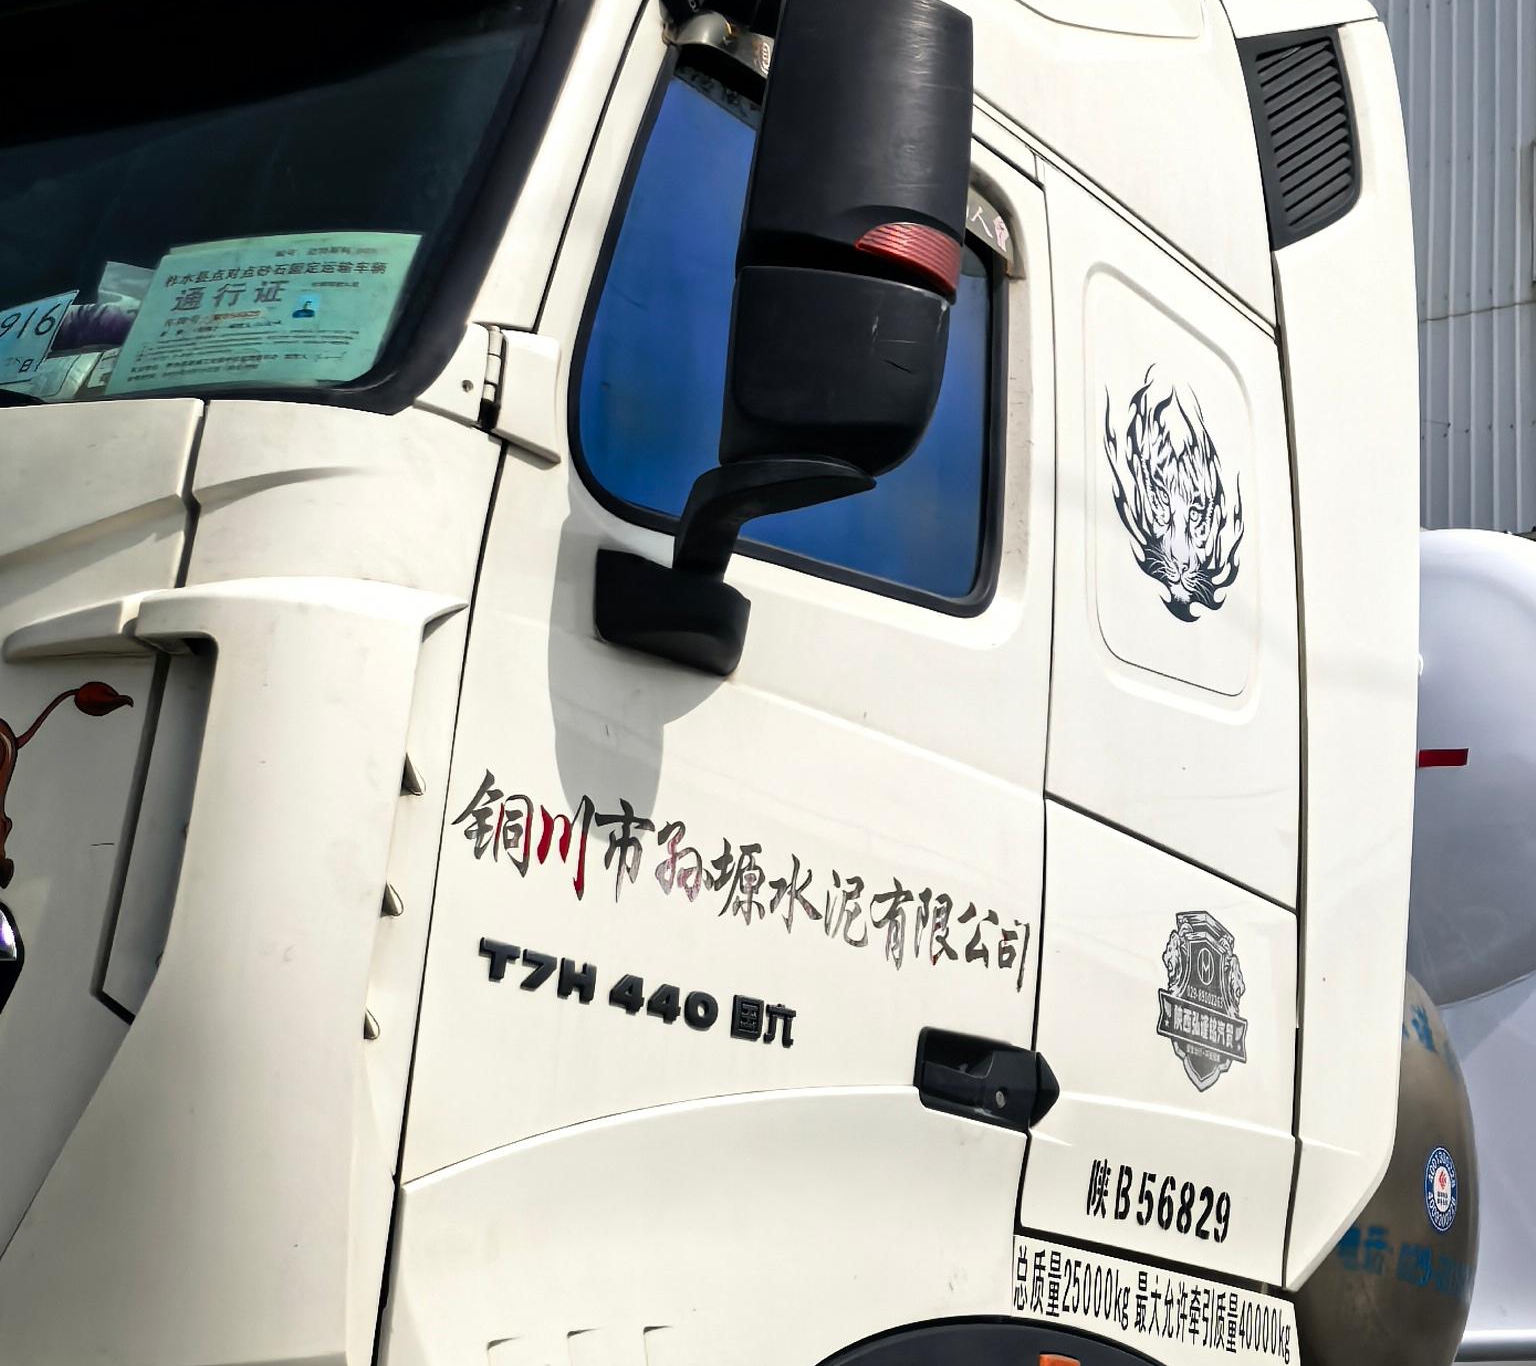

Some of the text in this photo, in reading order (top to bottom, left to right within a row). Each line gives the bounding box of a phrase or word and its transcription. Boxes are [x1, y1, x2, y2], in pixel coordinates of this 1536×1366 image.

[170, 280, 290, 312] 通行证
[479, 936, 598, 1005] T7H
[608, 973, 720, 1032] 440
[1086, 1158, 1232, 1244] 陕B56829
[1013, 1244, 1291, 1365] 总质量25000kg 最大允许牵引质量40000kg
